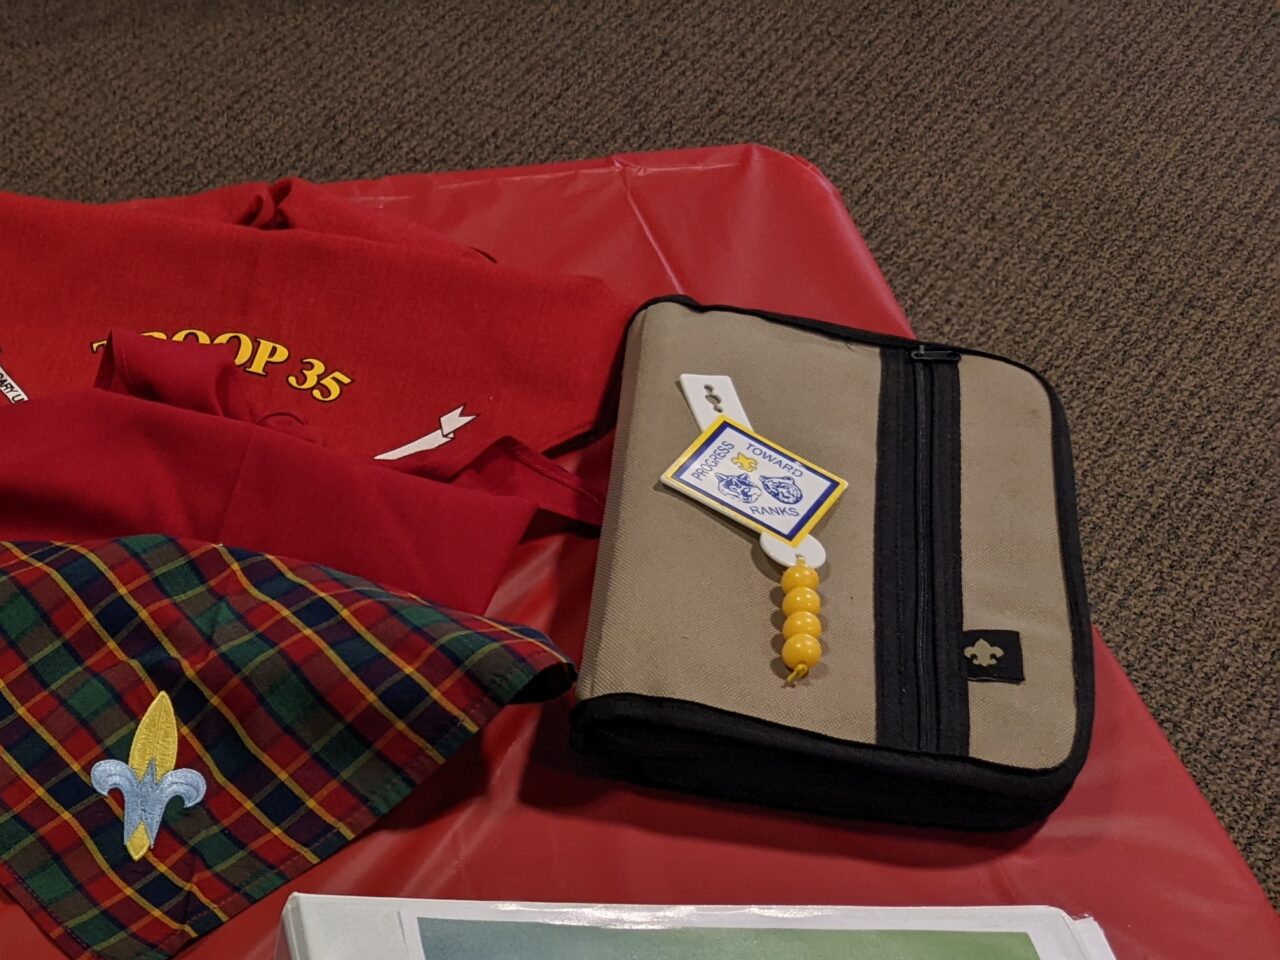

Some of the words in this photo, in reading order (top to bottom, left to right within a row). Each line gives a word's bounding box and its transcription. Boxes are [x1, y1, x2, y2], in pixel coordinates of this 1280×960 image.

[286, 357, 353, 402] 35
[691, 440, 735, 482] PROGRESS
[746, 442, 804, 478] TOWARD
[750, 506, 800, 517] RANKS
